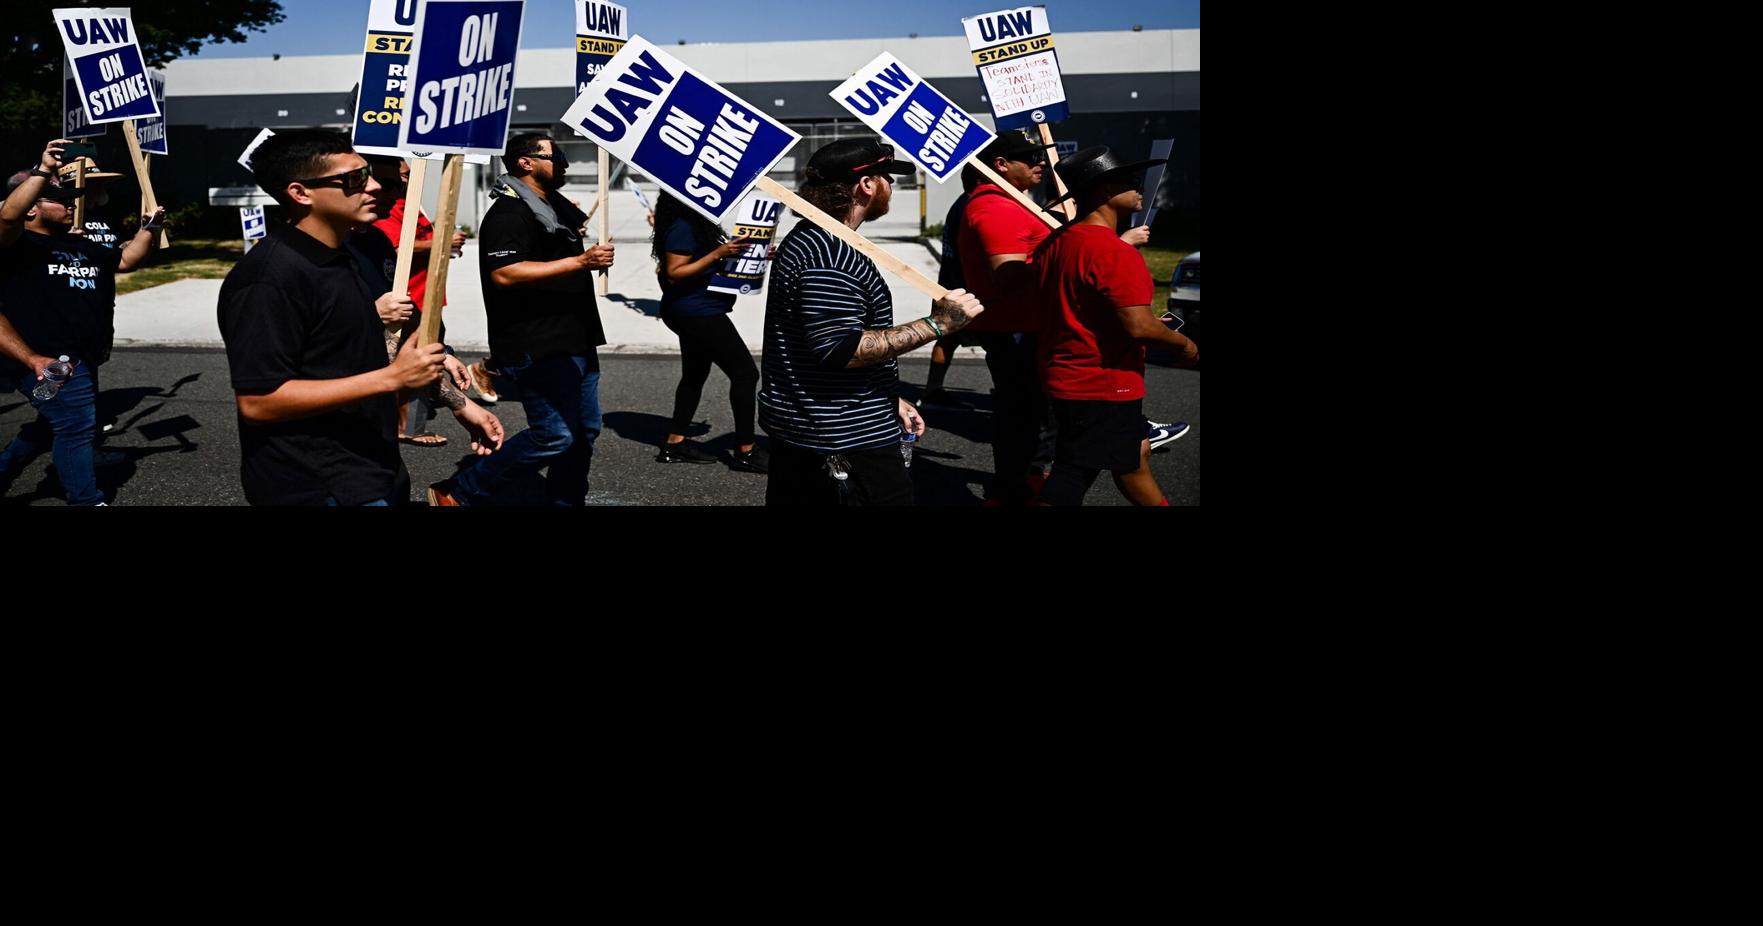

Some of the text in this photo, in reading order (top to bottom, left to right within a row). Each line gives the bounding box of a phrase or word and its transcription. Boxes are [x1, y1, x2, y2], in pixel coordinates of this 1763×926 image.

[62, 18, 129, 45] UAW
[586, 1, 621, 36] UAW
[977, 10, 1032, 42] UAW
[458, 12, 498, 67] ON
[580, 40, 614, 53] STAND
[979, 39, 1049, 62] STAND UP
[98, 53, 125, 82] ON
[89, 73, 148, 116] STRIKE
[415, 62, 512, 135] STRIKE
[580, 50, 675, 142] UAW
[845, 62, 913, 116] UAW
[138, 123, 163, 145] STRIKE
[658, 105, 705, 156] ON
[902, 100, 937, 134] ON
[684, 102, 759, 208] STRIKE
[919, 107, 970, 173] STRIKE
[752, 199, 780, 223] UA
[738, 228, 773, 237] STAN
[724, 258, 767, 274] TIER
